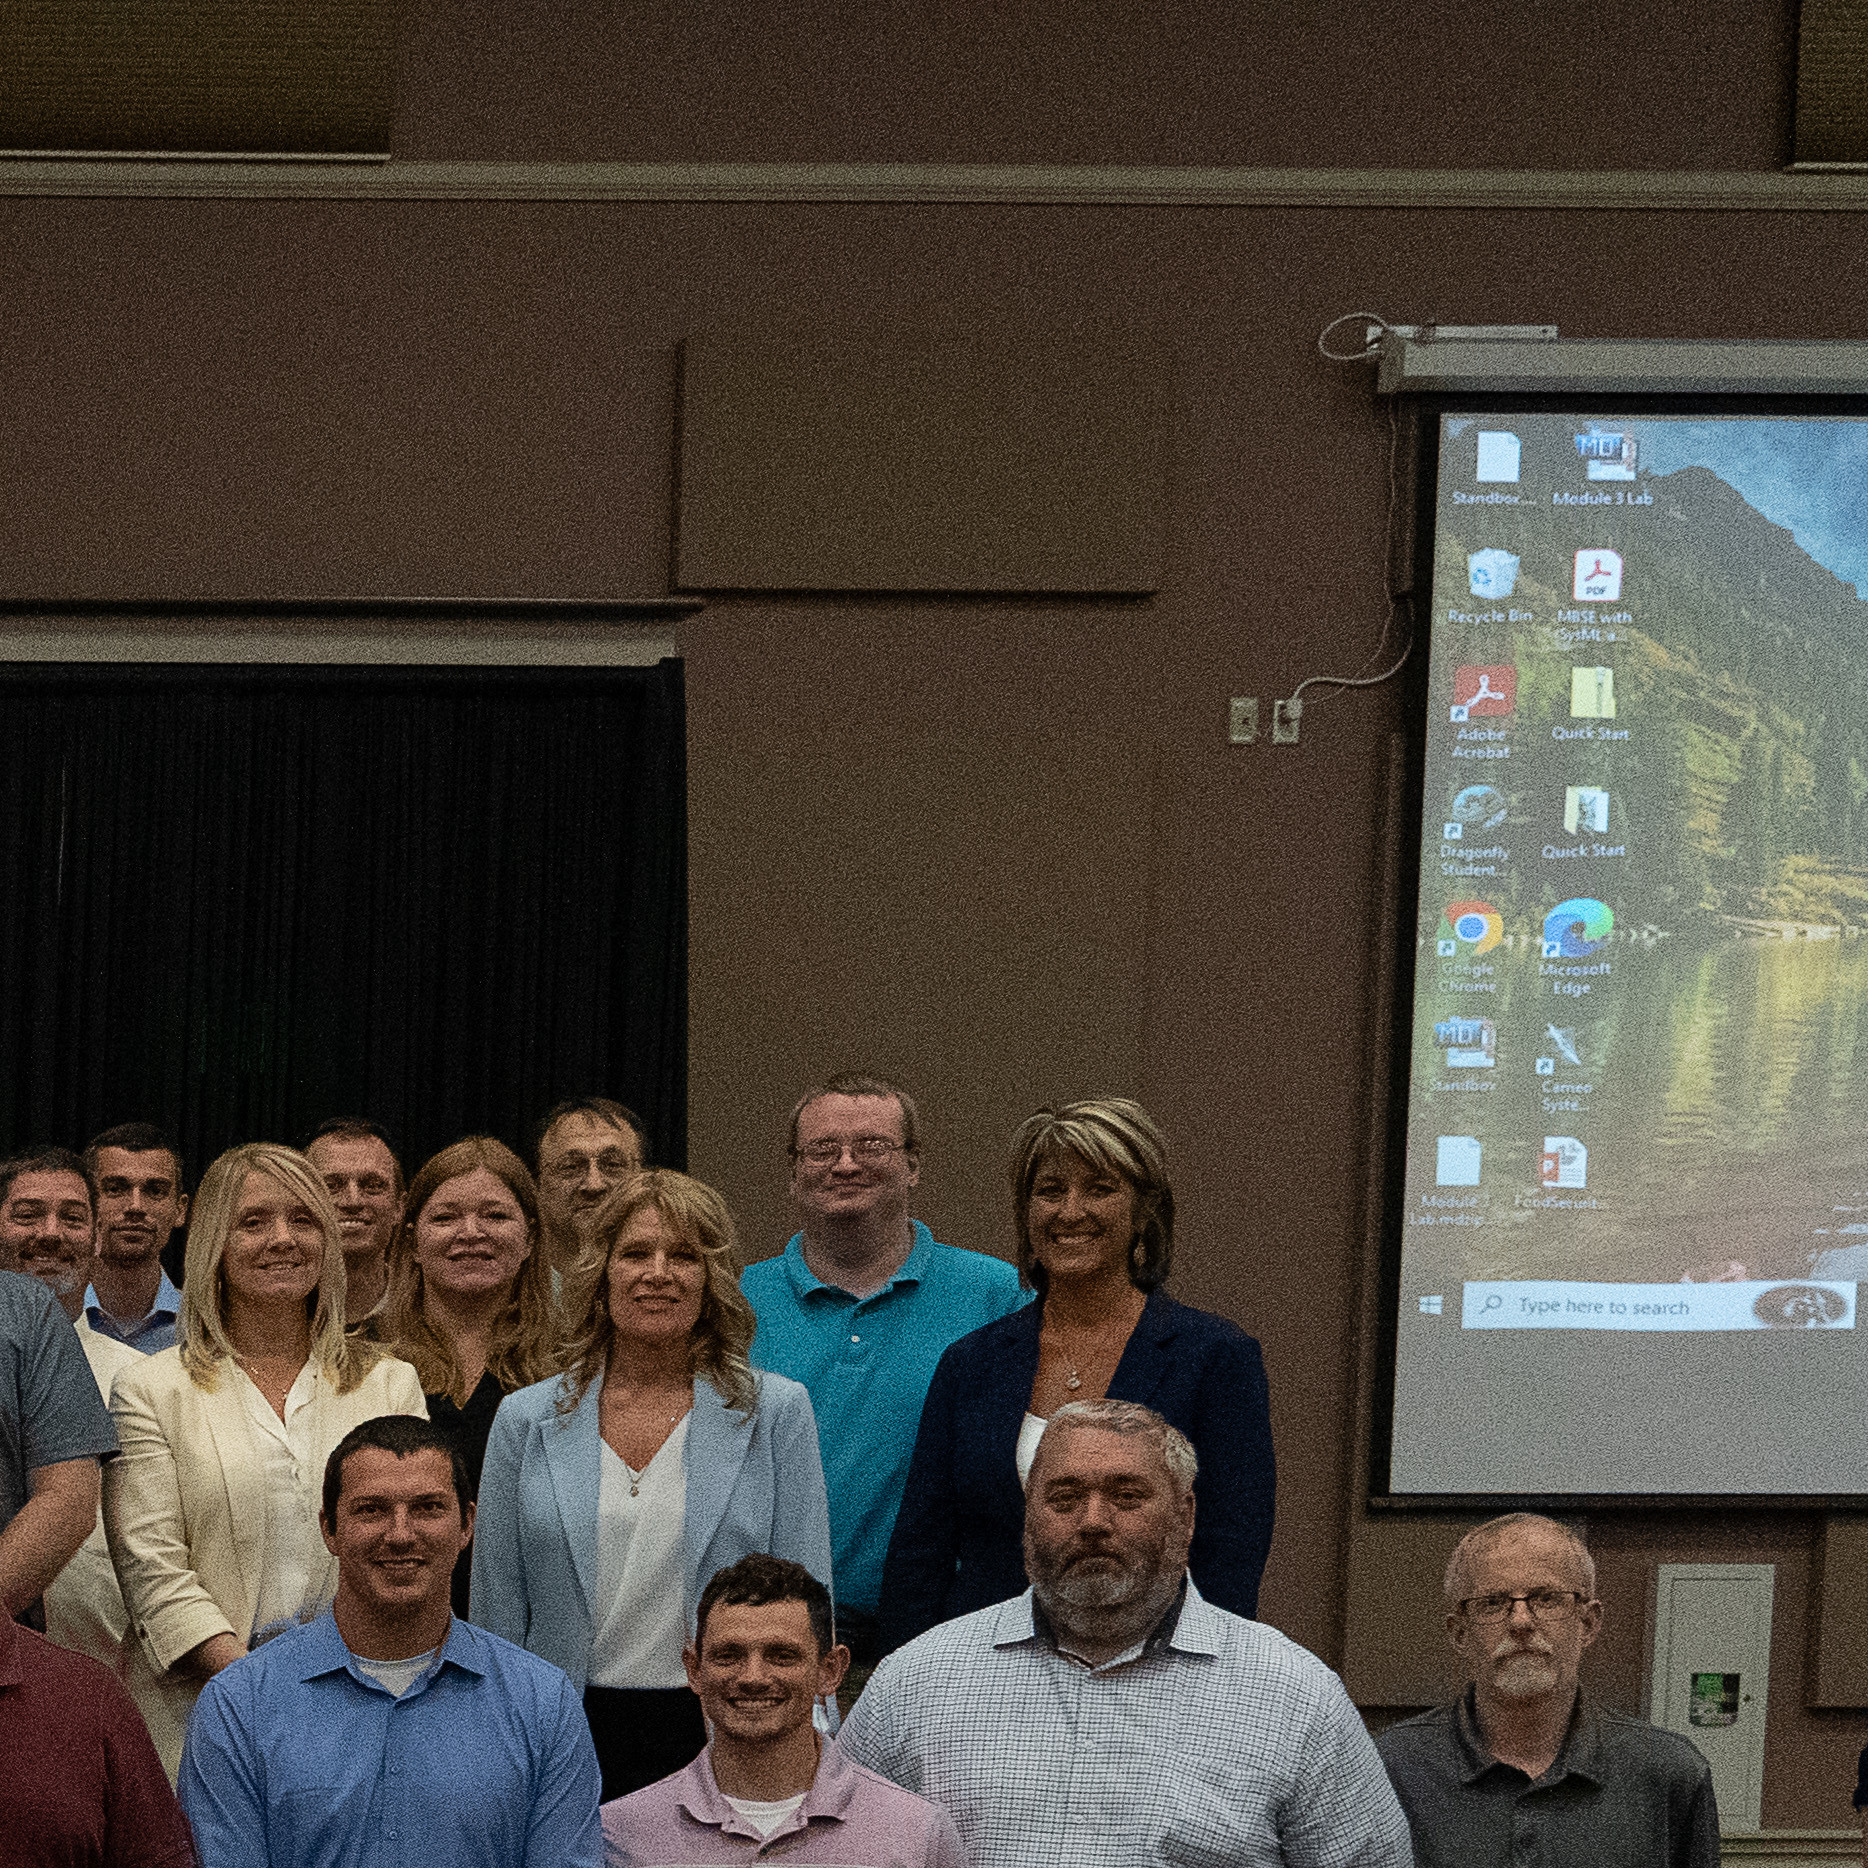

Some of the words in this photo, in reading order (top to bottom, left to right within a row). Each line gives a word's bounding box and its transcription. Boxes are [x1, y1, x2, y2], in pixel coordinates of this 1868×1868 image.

[1552, 492, 1611, 506] Module
[1615, 492, 1623, 505] 3
[1627, 491, 1654, 506] Lab
[1585, 586, 1607, 596] PDF
[1448, 609, 1504, 624] Recycle
[1508, 608, 1533, 621] Bin
[1557, 609, 1596, 623] MBSE
[1599, 611, 1633, 624] with
[1457, 727, 1507, 741] Adobe
[1552, 726, 1594, 741] Quick
[1598, 727, 1630, 741] Start
[1451, 745, 1510, 759] Acrobat
[1440, 844, 1510, 861] Dragonfly
[1541, 844, 1587, 859] Quick
[1591, 843, 1626, 858] Start
[1442, 963, 1494, 978] Google
[1538, 962, 1612, 977] Microsoft
[1438, 981, 1497, 994] Chrome
[1553, 981, 1591, 997] Edge
[1541, 1079, 1593, 1094] Cameo
[1421, 1194, 1479, 1209] Module
[1519, 1296, 1561, 1315] Type
[1566, 1297, 1604, 1314] here
[1609, 1299, 1627, 1314] to
[1632, 1299, 1690, 1316] search
